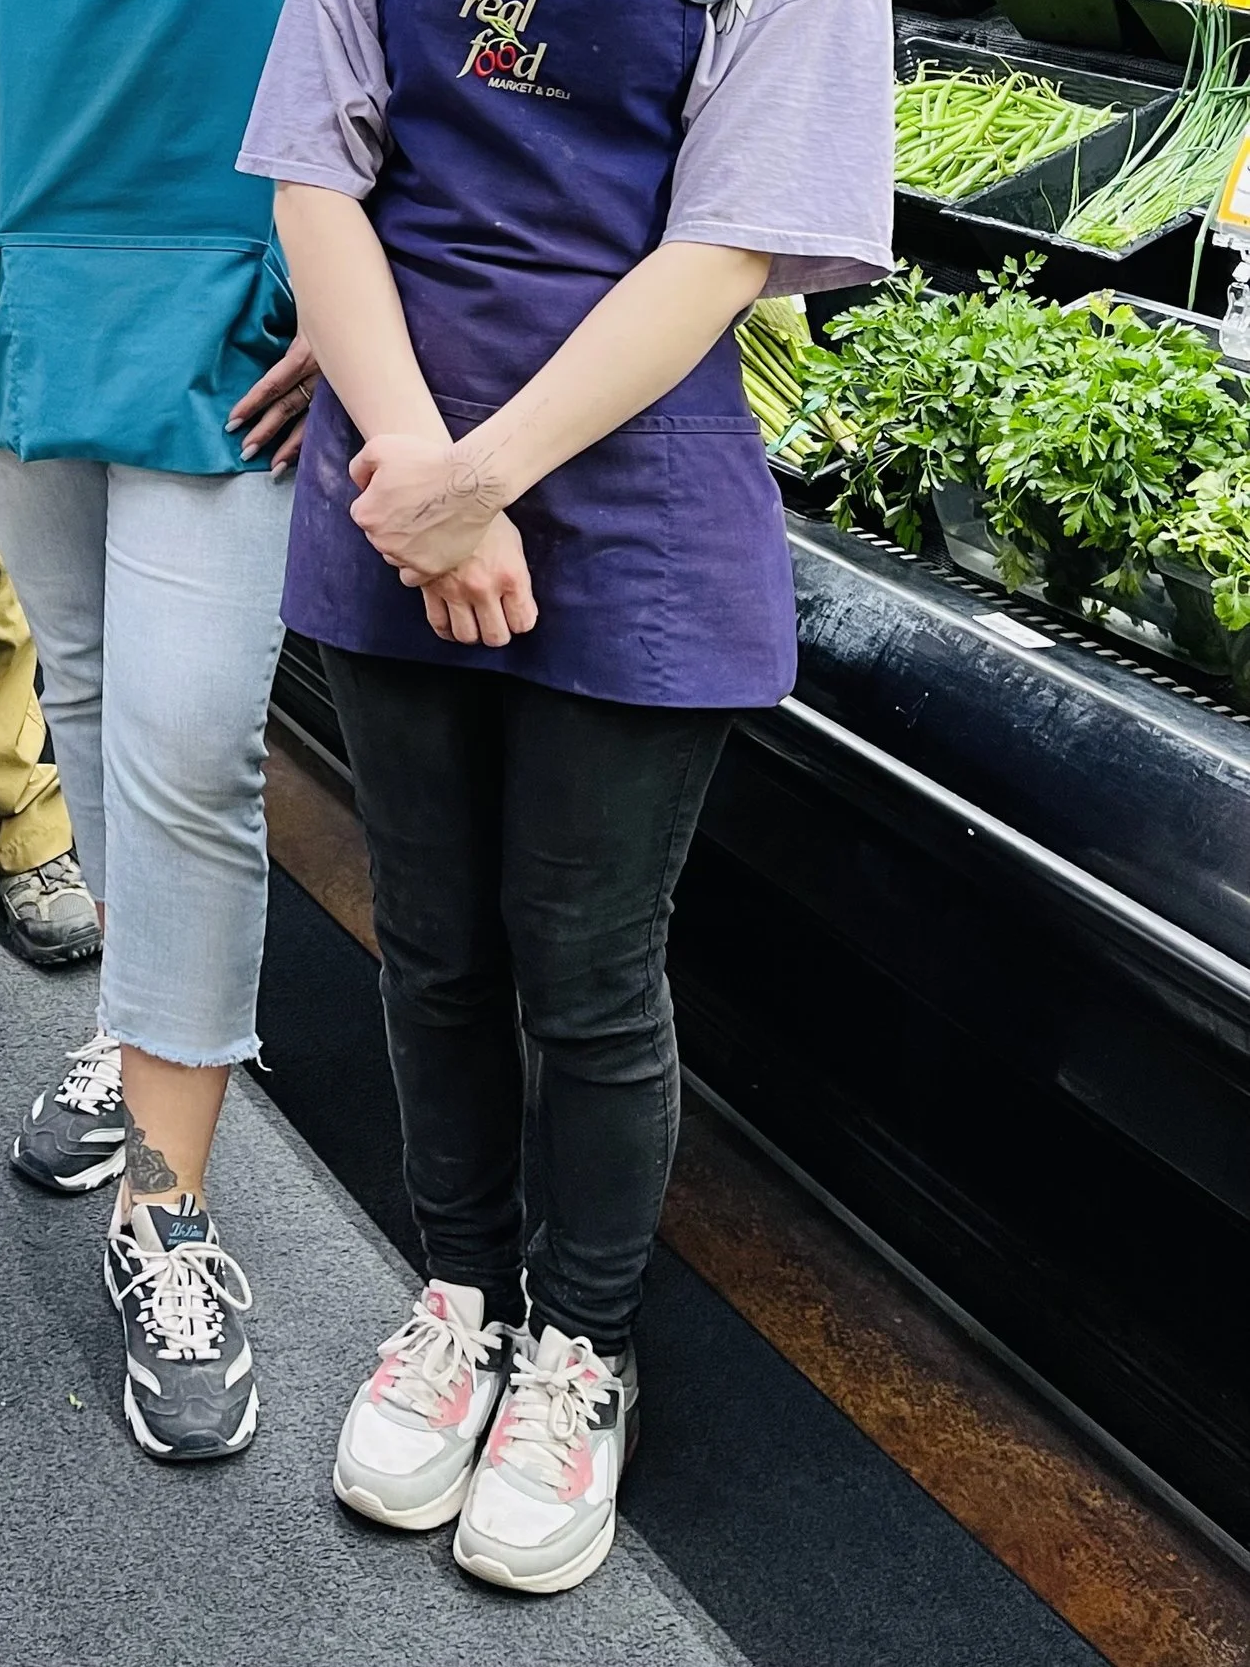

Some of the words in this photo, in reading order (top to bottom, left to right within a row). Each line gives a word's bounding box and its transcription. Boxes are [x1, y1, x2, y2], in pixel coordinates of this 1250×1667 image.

[456, 29, 548, 82] food
[488, 77, 535, 94] MARKET
[535, 86, 543, 96] &
[546, 87, 571, 100] DELI
